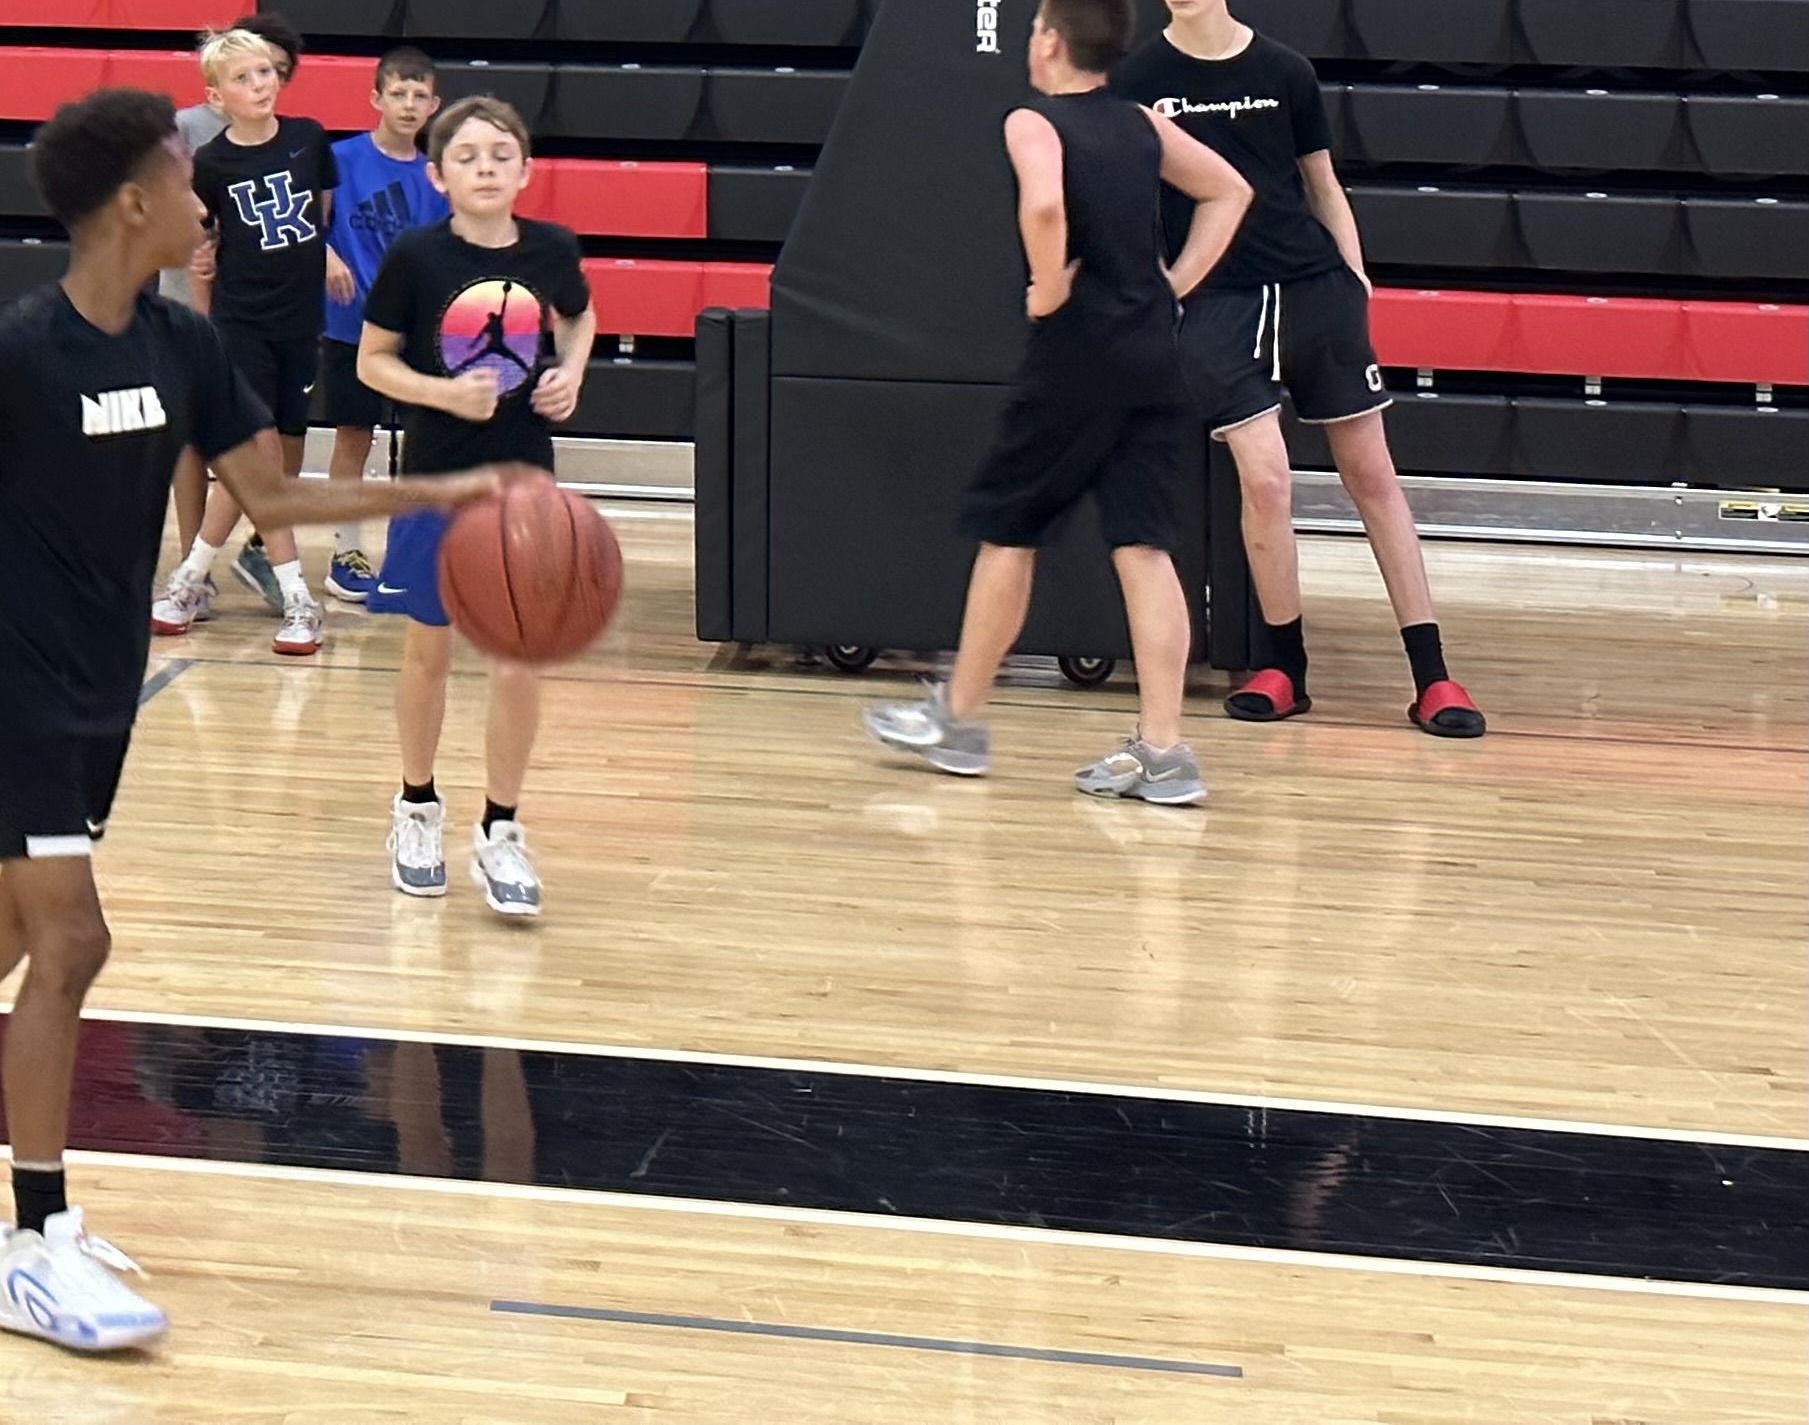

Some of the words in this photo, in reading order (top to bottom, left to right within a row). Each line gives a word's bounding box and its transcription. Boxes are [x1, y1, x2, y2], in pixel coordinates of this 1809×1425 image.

[1153, 96, 1279, 119] Champion
[227, 170, 317, 250] UK
[80, 386, 167, 435] NIKE
